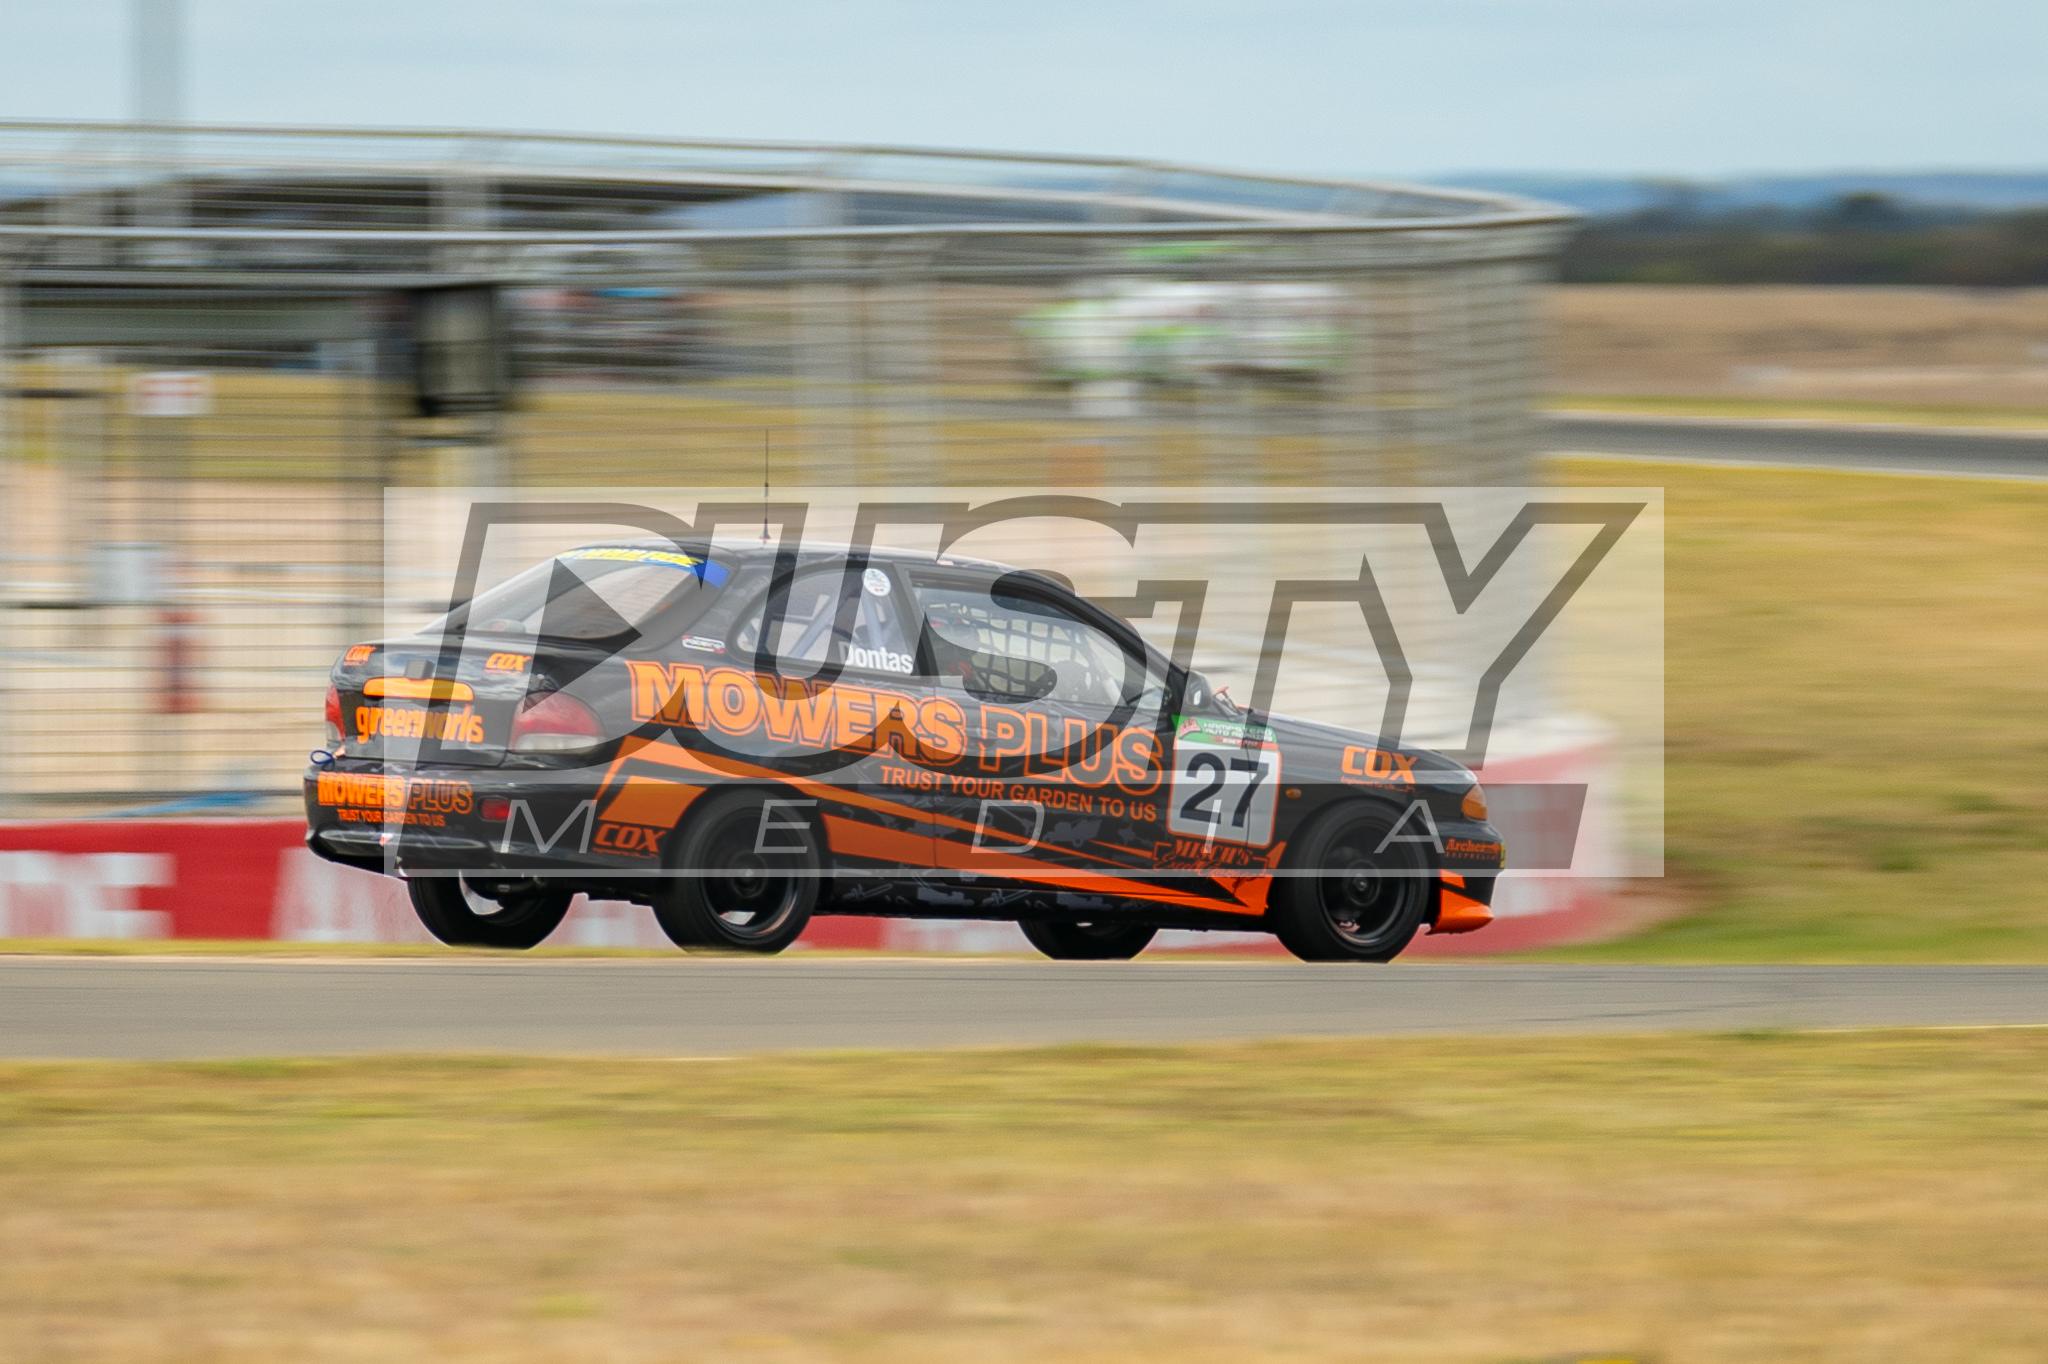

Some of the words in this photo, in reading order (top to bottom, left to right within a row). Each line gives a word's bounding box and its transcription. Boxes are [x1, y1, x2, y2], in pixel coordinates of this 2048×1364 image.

[486, 653, 532, 672] COX
[838, 641, 913, 675] Dontas
[625, 660, 966, 766] MOWERS
[979, 705, 1163, 795] PLUS
[1342, 745, 1418, 784] COX
[317, 772, 405, 807] MOWERS
[408, 777, 473, 815] PLUS
[880, 765, 943, 791] TRUST
[950, 776, 1004, 800] YOUR
[1009, 784, 1093, 814] GARDEN
[1098, 796, 1125, 818] TO
[1130, 804, 1157, 823] US
[1179, 752, 1269, 828] 27
[594, 823, 666, 853] COX
